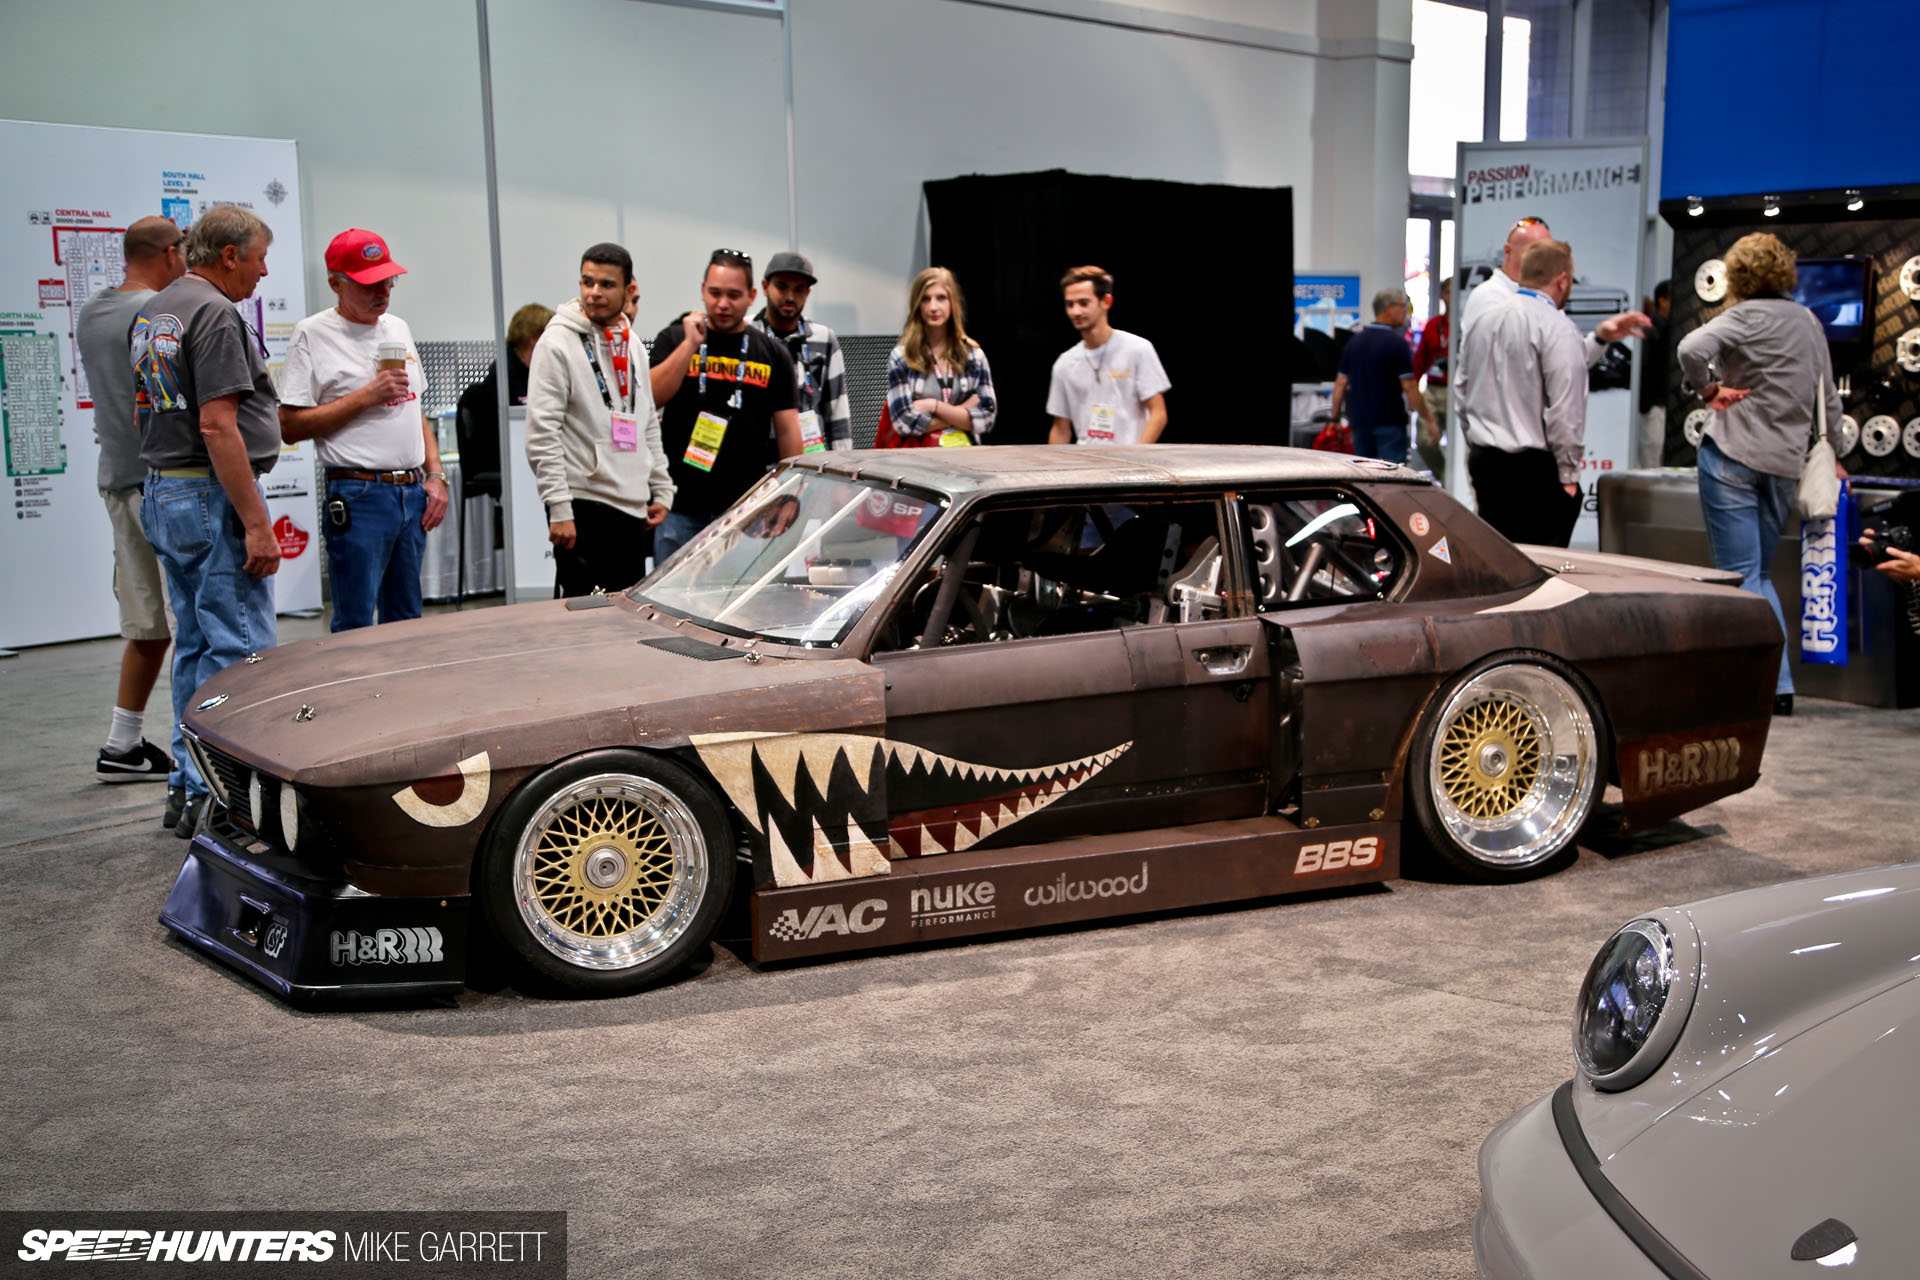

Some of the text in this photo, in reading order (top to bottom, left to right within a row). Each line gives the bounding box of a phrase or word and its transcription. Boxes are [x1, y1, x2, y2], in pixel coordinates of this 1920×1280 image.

[162, 171, 206, 181] SOUTH HALL
[1465, 164, 1641, 205] PERFORMANCE
[1467, 165, 1530, 185] PASSION
[55, 209, 90, 217] CENTRAL
[24, 312, 44, 320] HALL
[1801, 561, 1838, 652] H&R
[1638, 743, 1703, 792] H&R
[1294, 837, 1378, 874] BBS
[910, 881, 996, 912] nuke
[1024, 862, 1149, 907] wilwood
[781, 899, 888, 940] VAC
[911, 910, 997, 928] PERFORMANCE
[330, 929, 406, 966] H&R
